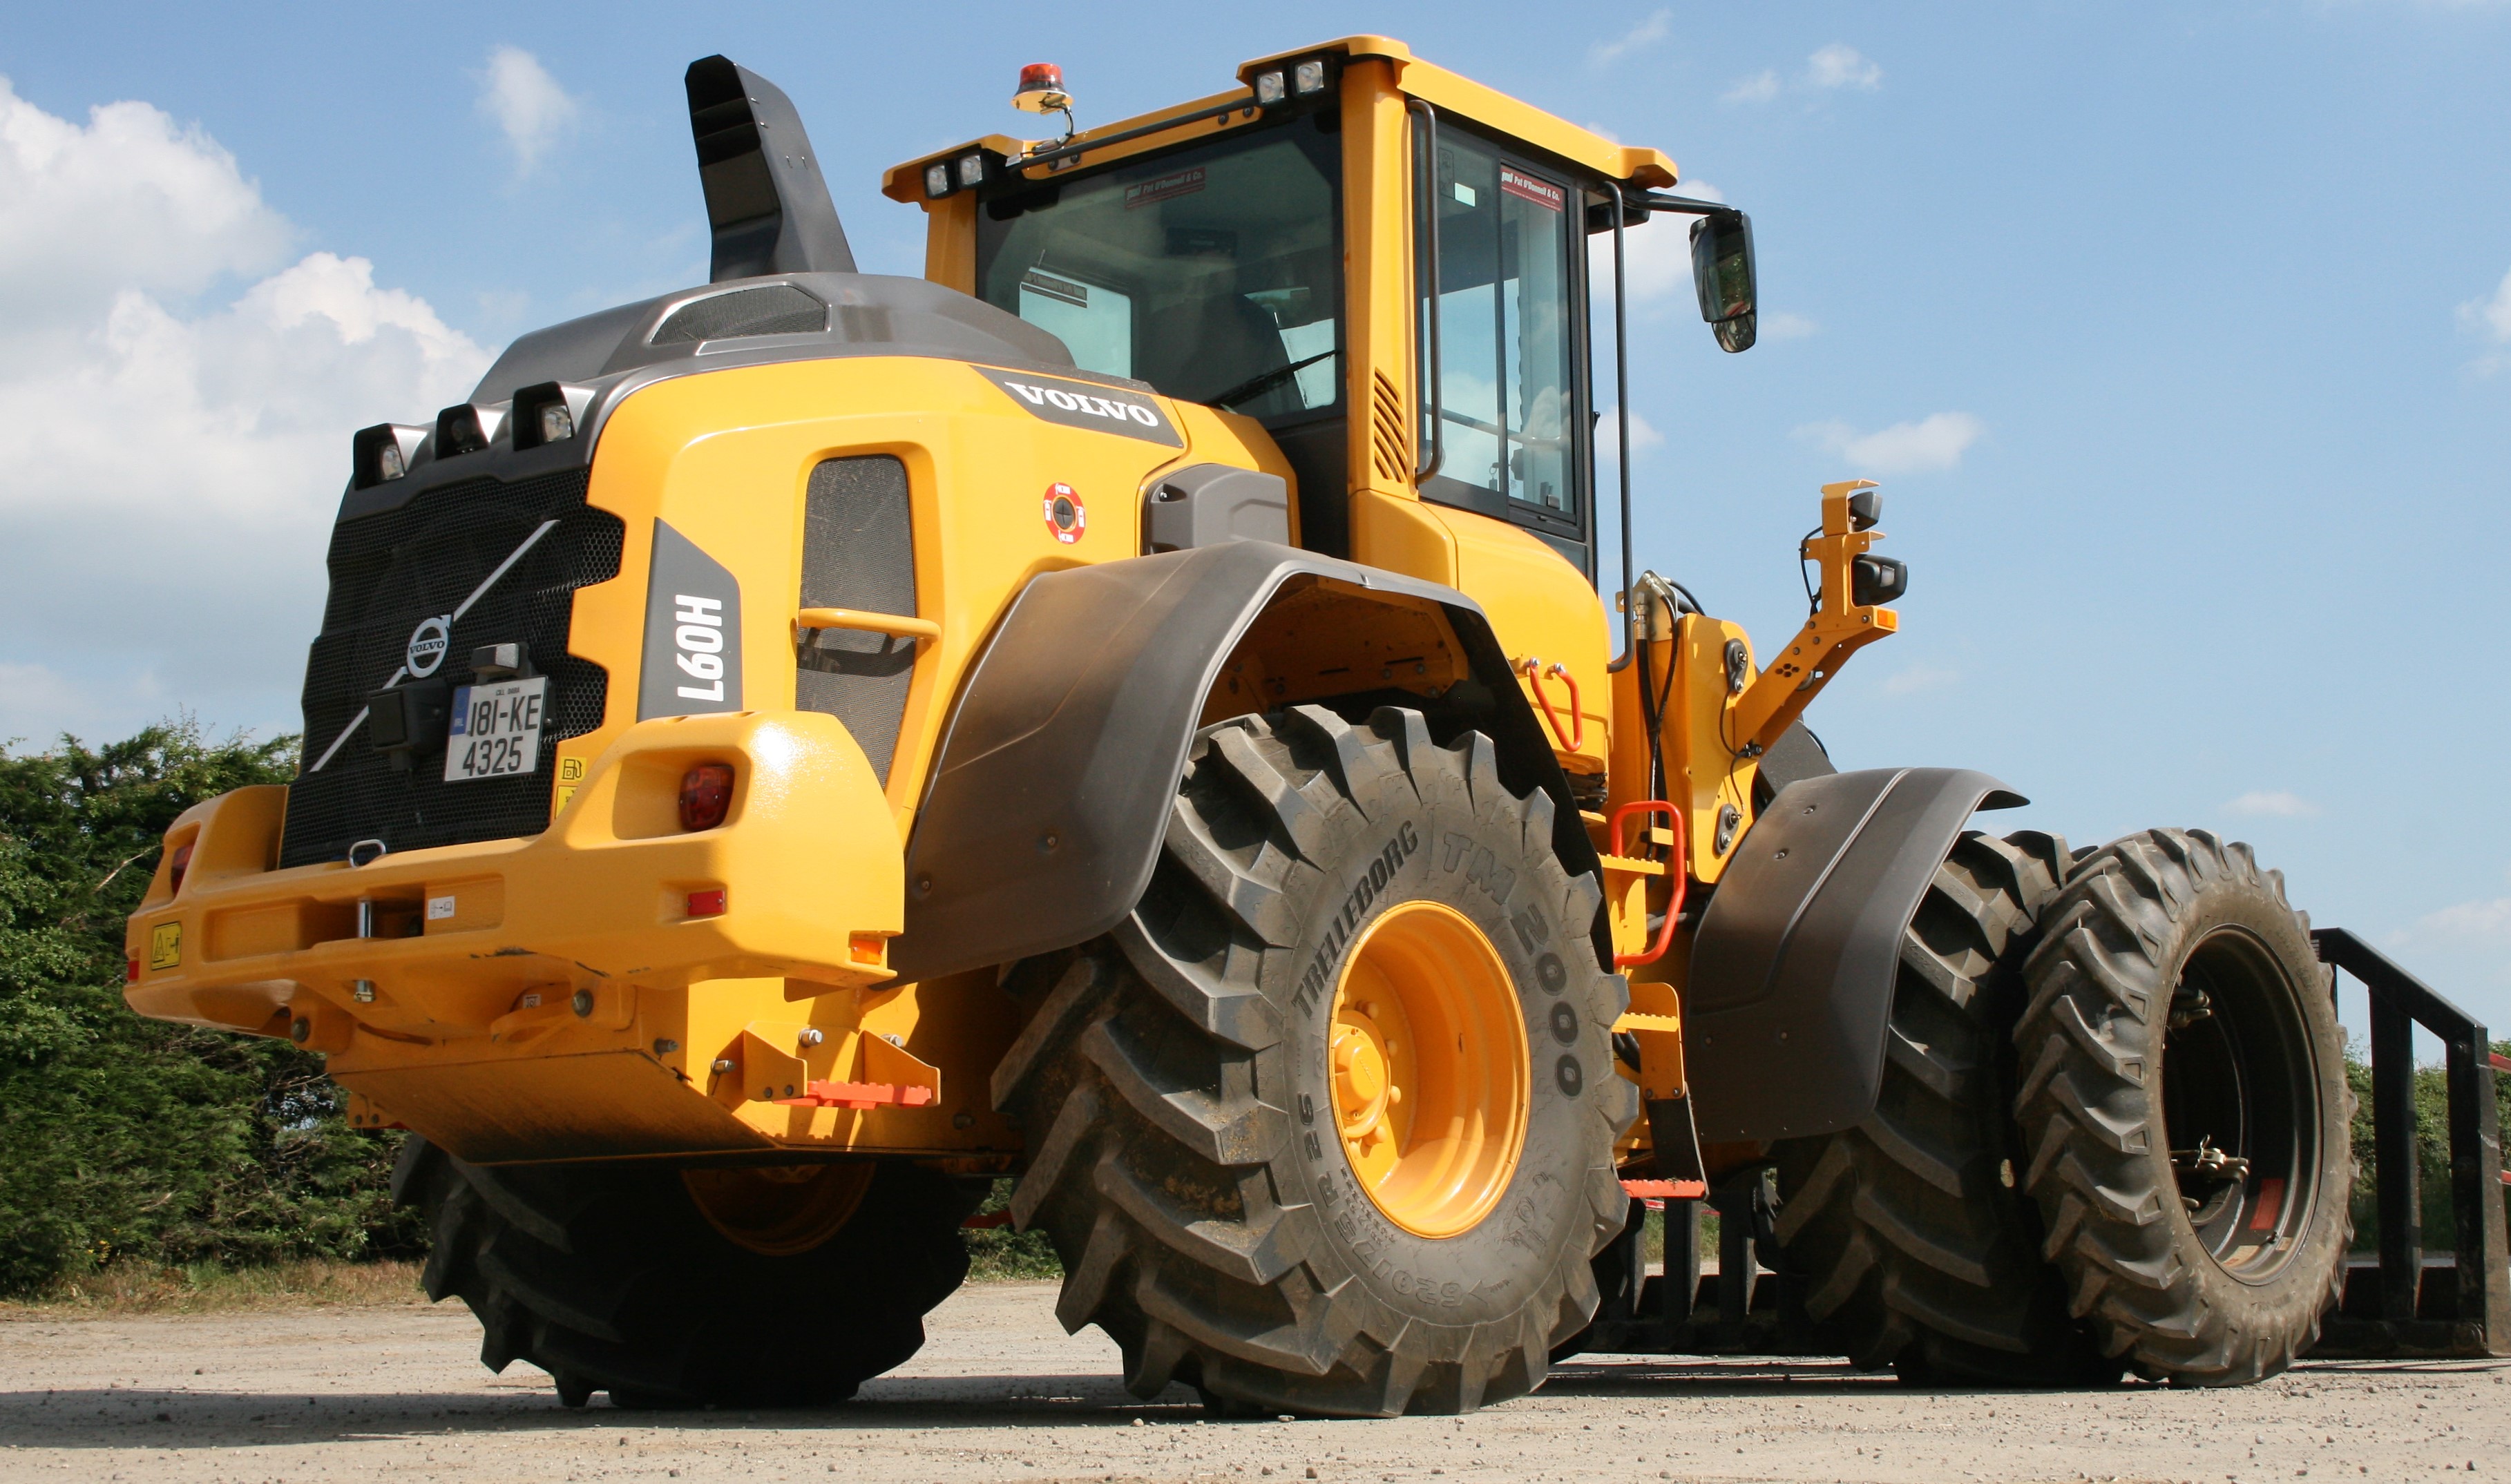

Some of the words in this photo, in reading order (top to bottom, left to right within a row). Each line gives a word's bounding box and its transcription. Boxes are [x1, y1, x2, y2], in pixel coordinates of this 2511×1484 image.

[1143, 182, 1154, 193] Pat
[1155, 175, 1185, 190] O'Donnell
[1186, 173, 1192, 182] &
[1193, 171, 1203, 180] Co.
[1514, 175, 1523, 186] Pat
[1523, 180, 1547, 196] O'Donnell
[1547, 189, 1552, 198] &
[1552, 191, 1560, 202] Co.
[1004, 381, 1159, 427] VOLVO
[409, 640, 446, 655] VOLVO
[675, 594, 724, 702] L60H
[468, 694, 542, 738] 181-KE
[462, 735, 524, 777] 4325
[1290, 820, 1418, 1020] TRELLEBORG
[1443, 831, 1516, 906] TM
[1510, 902, 1583, 1100] 2000
[1297, 1091, 1323, 1163] 26
[1317, 1170, 1339, 1208] R
[1334, 1210, 1464, 1308] 620/75
